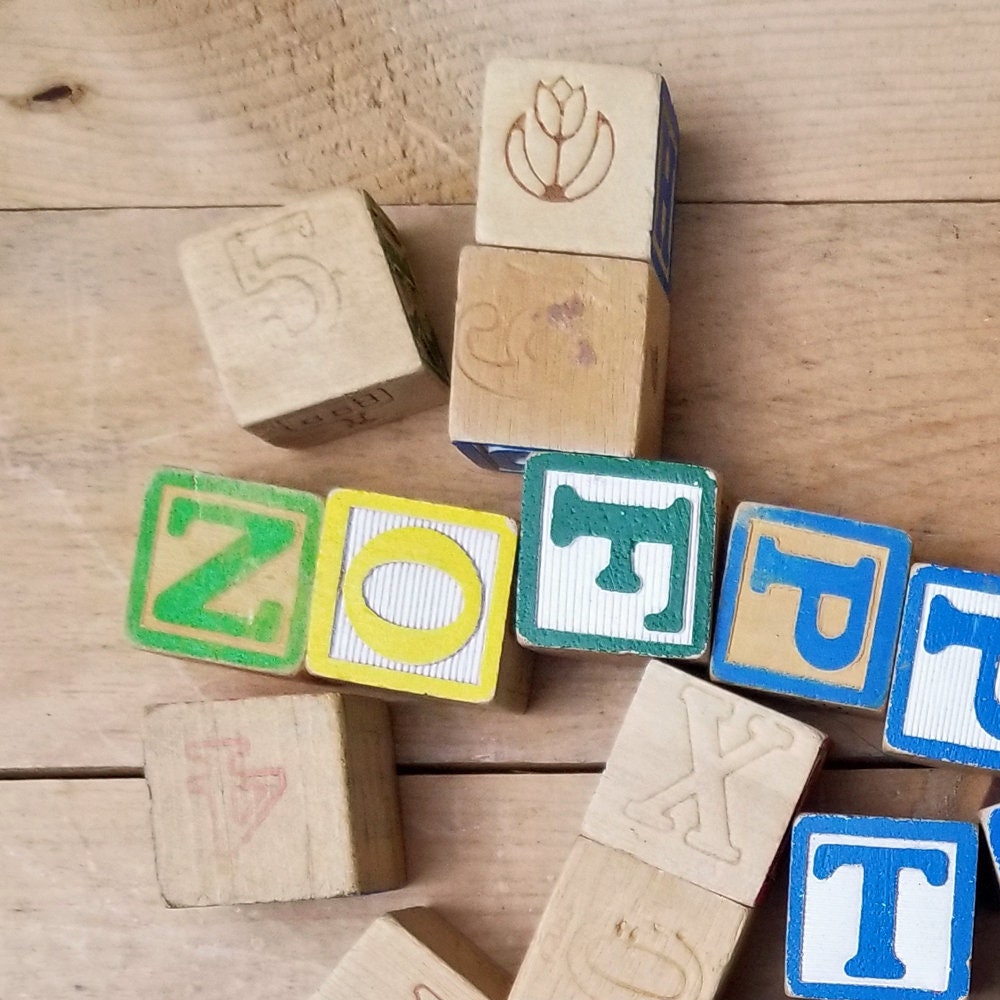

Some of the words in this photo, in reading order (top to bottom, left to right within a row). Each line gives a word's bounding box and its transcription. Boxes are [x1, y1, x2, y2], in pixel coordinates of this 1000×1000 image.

[222, 209, 343, 350] 5
[343, 526, 483, 666] O
[549, 484, 692, 634] F
[750, 535, 877, 671] P
[623, 685, 795, 866] X
[813, 844, 949, 980] T
